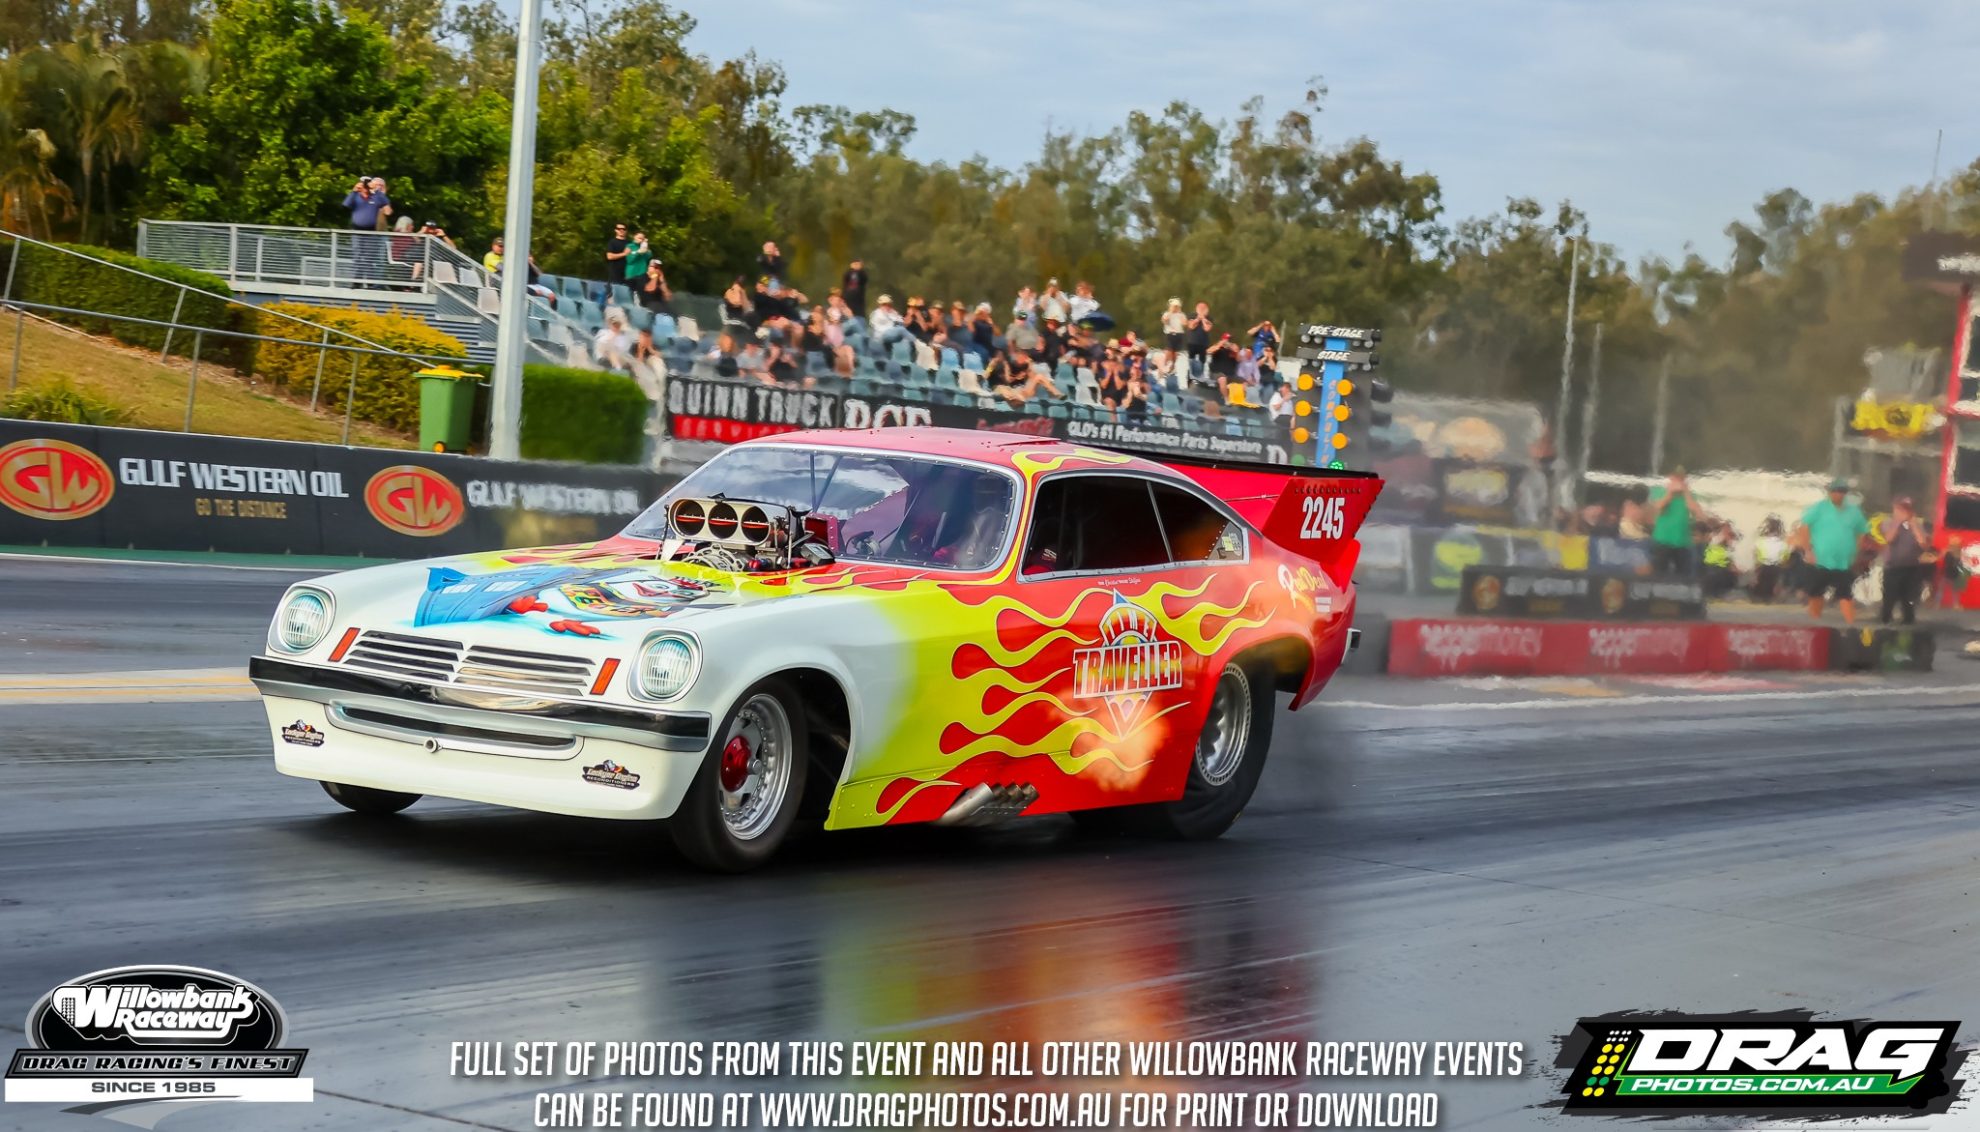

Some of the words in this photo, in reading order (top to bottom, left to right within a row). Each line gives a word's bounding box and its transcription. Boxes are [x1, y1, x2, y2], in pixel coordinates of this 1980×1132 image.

[1308, 325, 1364, 339] PRE-STAGE
[1317, 351, 1351, 362] STAGE
[668, 380, 748, 420] QUINN
[755, 388, 834, 427] TRUCK
[1115, 425, 1180, 447] Performance
[1182, 433, 1208, 450] Parts
[1210, 436, 1262, 455] Superstore
[119, 457, 187, 487] GULF
[189, 462, 308, 495] WESTERN
[310, 470, 349, 498] OIL
[195, 498, 211, 516] GO
[215, 499, 235, 516] THE
[238, 500, 287, 519] DISTANCE
[1300, 496, 1345, 540] 2245
[1073, 641, 1182, 698] TRAVELLER
